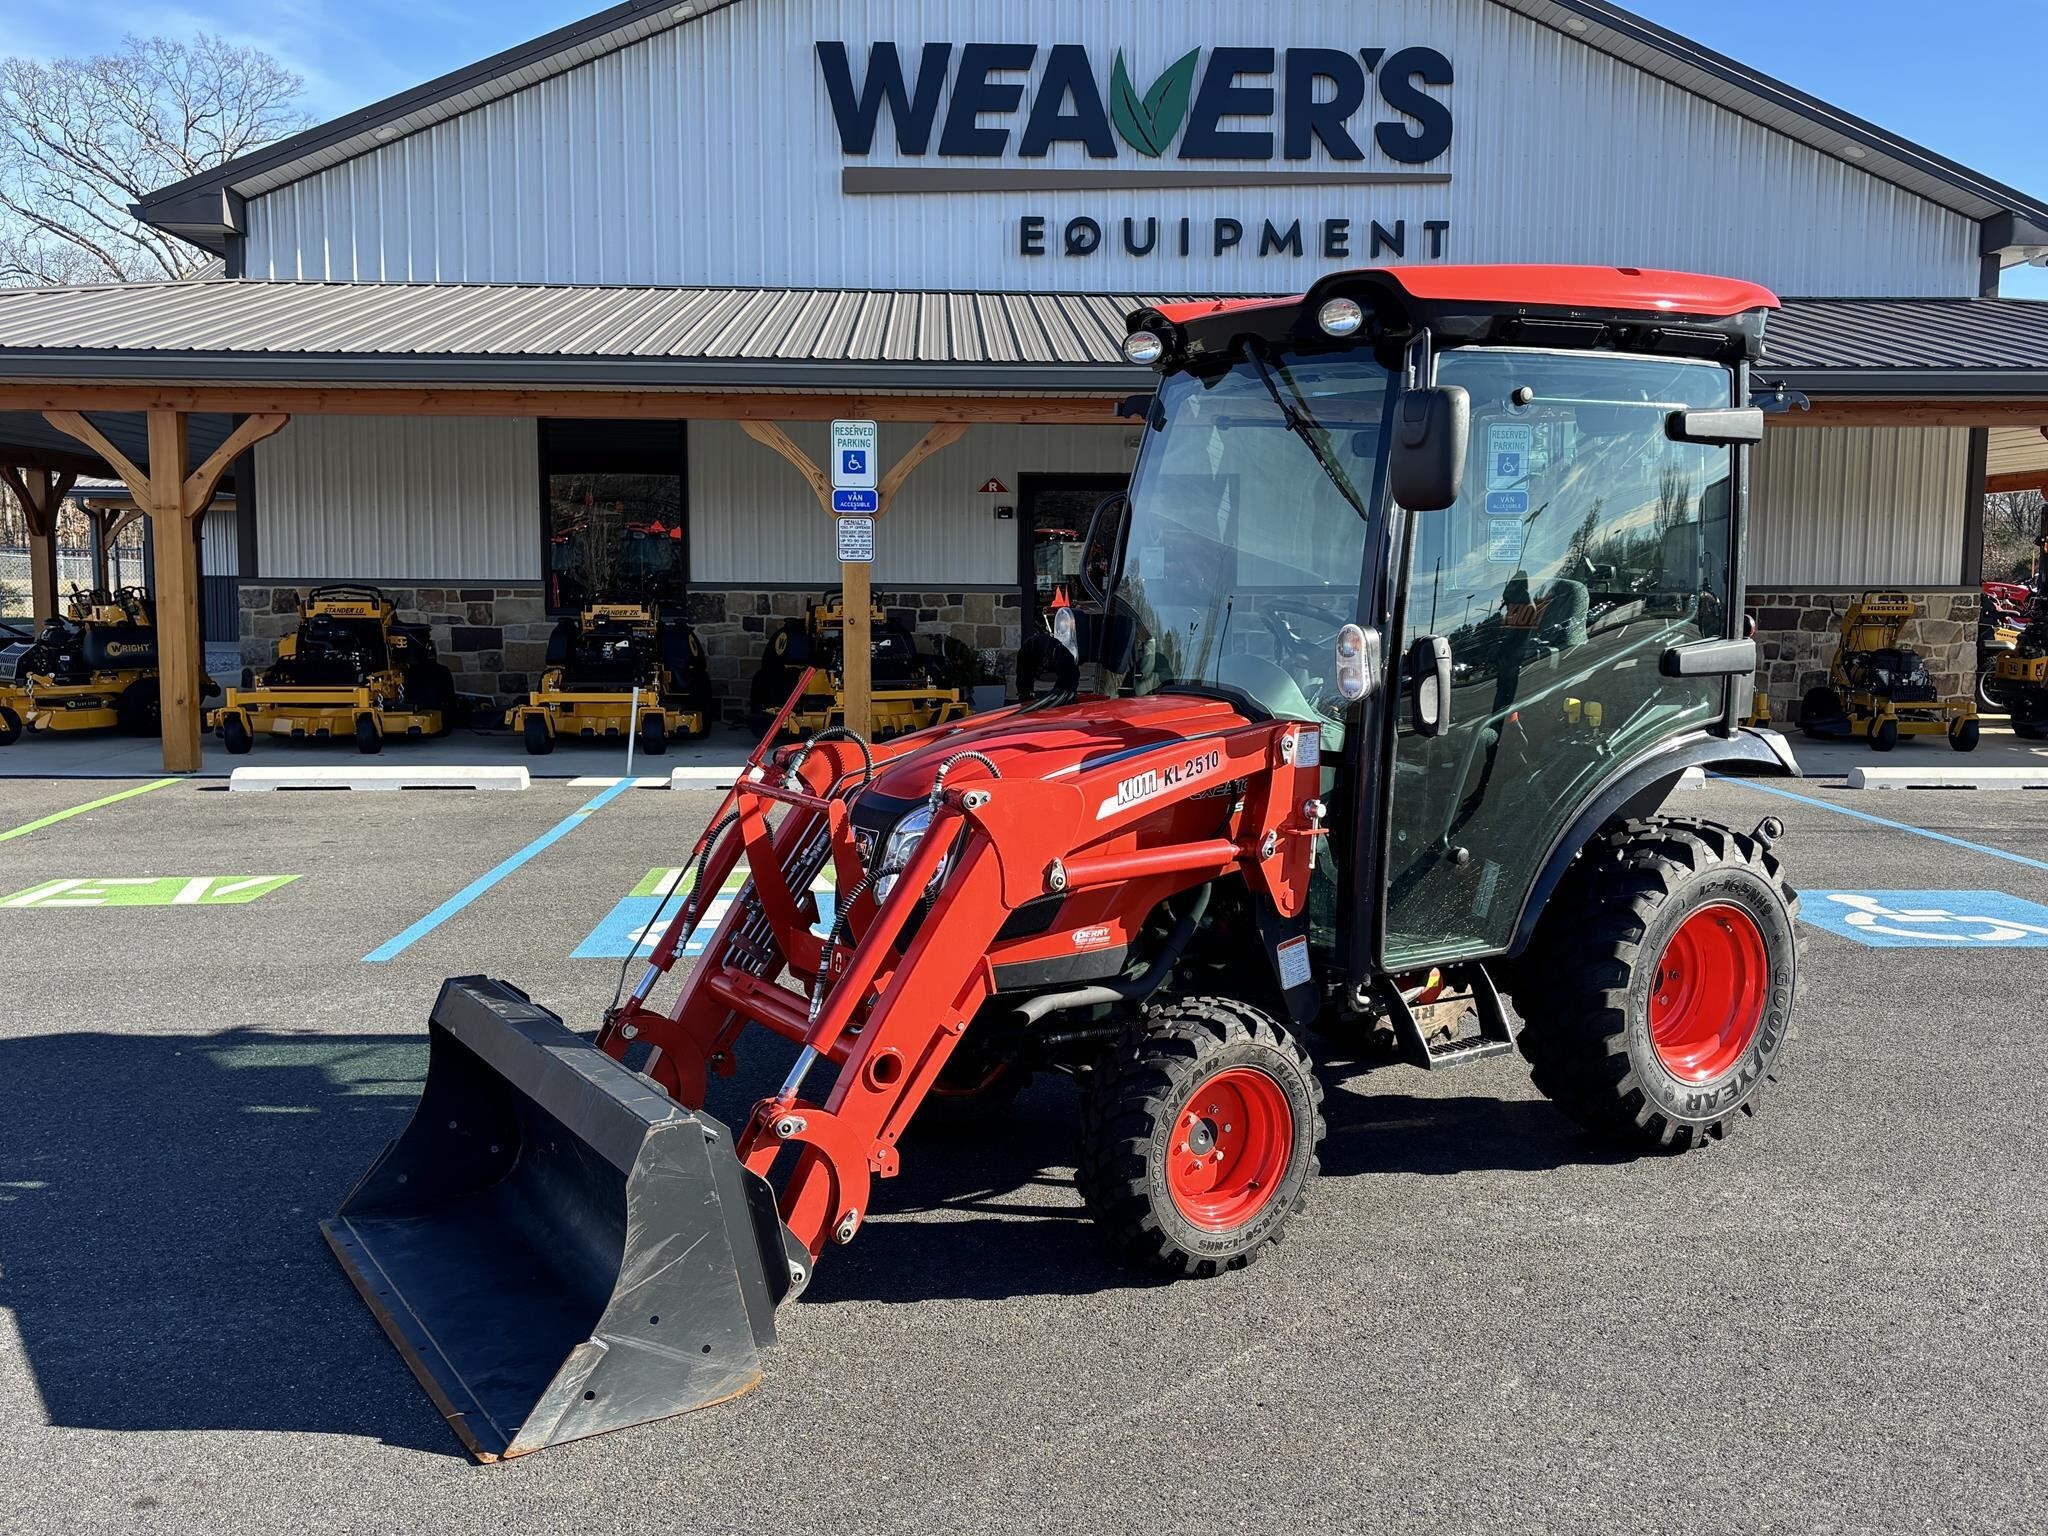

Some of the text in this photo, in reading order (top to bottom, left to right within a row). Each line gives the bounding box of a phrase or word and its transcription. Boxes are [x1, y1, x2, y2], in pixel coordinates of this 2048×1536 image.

[815, 41, 1454, 163] WEAVER'S
[1020, 215, 1450, 258] EQUIPMENT
[834, 427, 874, 436] RESERVED
[1491, 430, 1528, 439] RESERVED
[837, 438, 871, 448] PARKING
[1493, 441, 1525, 451] PARKING
[988, 482, 998, 492] R
[847, 494, 863, 502] VAN
[110, 643, 150, 655] WRIGHT
[1117, 768, 1158, 806] KIOTI
[1163, 765, 1183, 787] KL
[1185, 750, 1220, 779] 2510
[1685, 964, 1790, 1112] GOODYEAR
[1151, 1056, 1220, 1198] GOODYEAR
